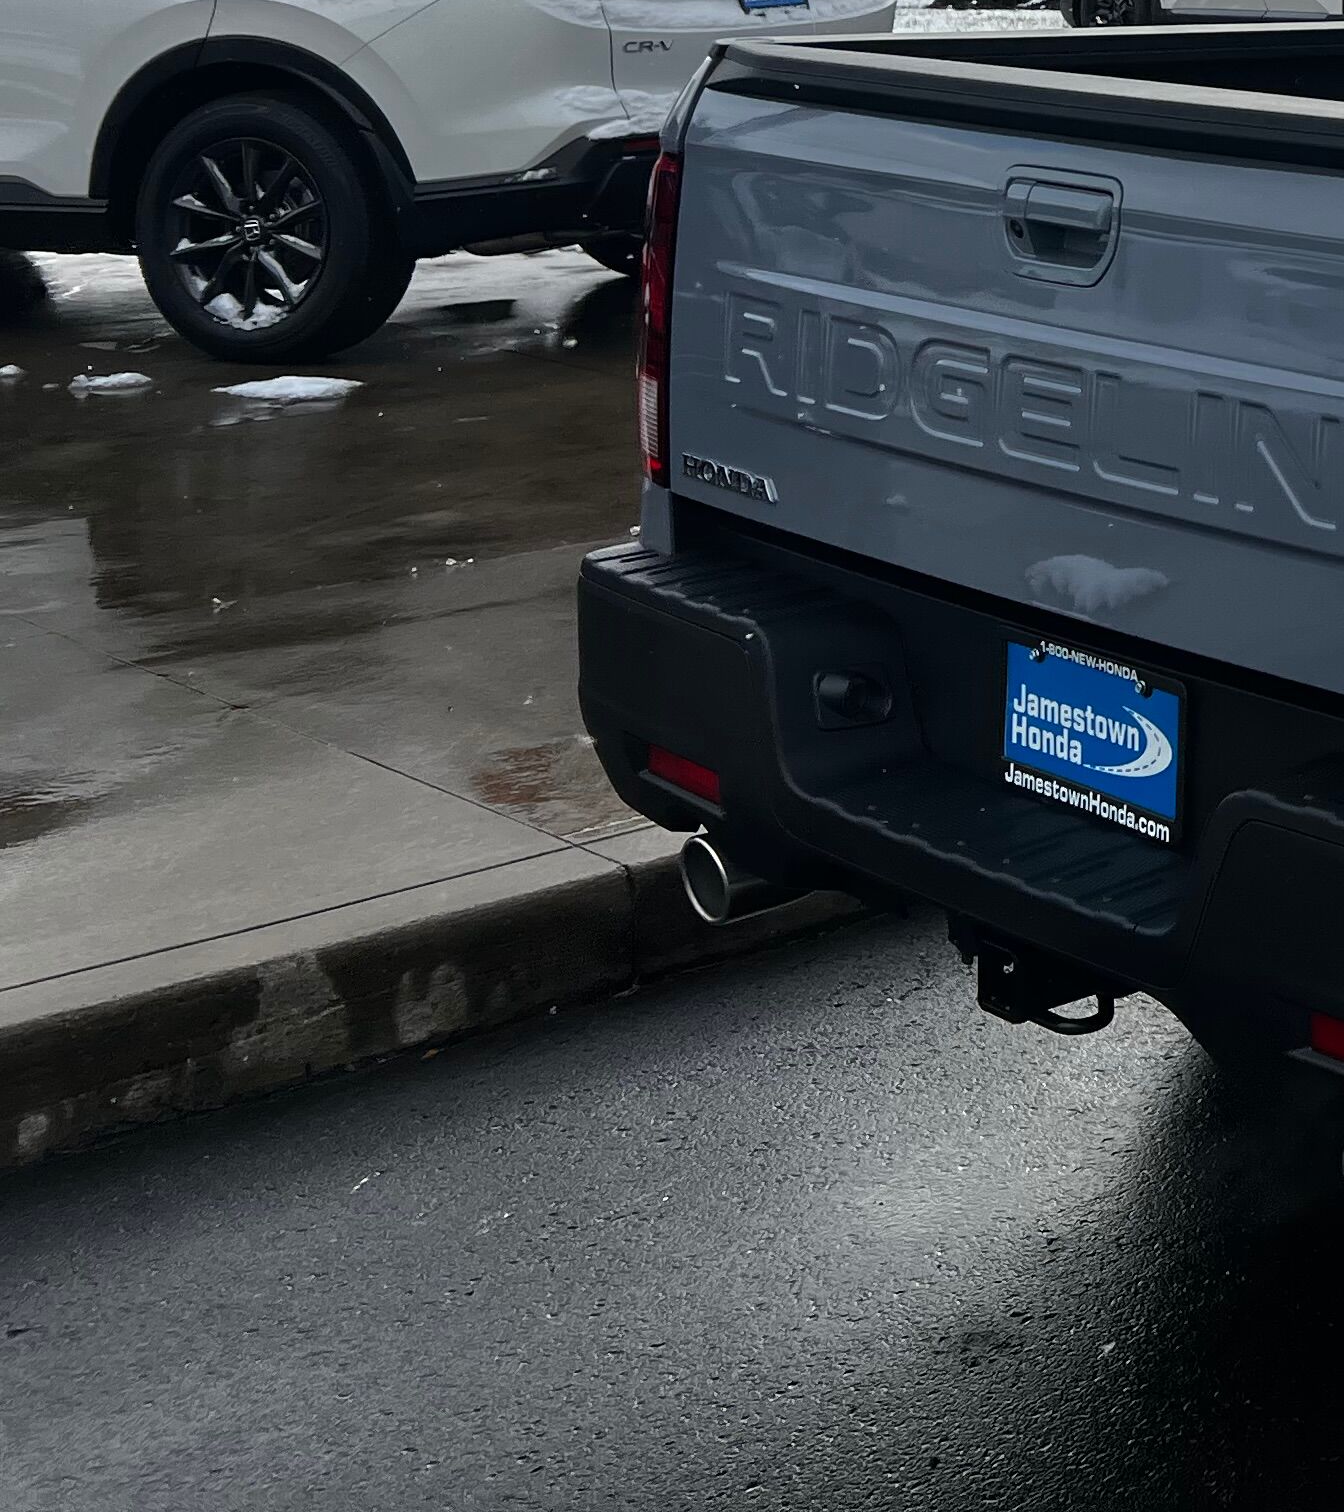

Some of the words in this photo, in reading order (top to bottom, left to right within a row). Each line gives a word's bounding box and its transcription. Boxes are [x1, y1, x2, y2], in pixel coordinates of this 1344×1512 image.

[623, 40, 673, 53] CR-V
[681, 452, 780, 504] HONDA
[1040, 640, 1139, 682] 1-800-NEW-HONDA
[1011, 713, 1082, 766] Honda
[1013, 684, 1140, 752] Jamestown
[1004, 762, 1170, 843] JamestownHonda.com
